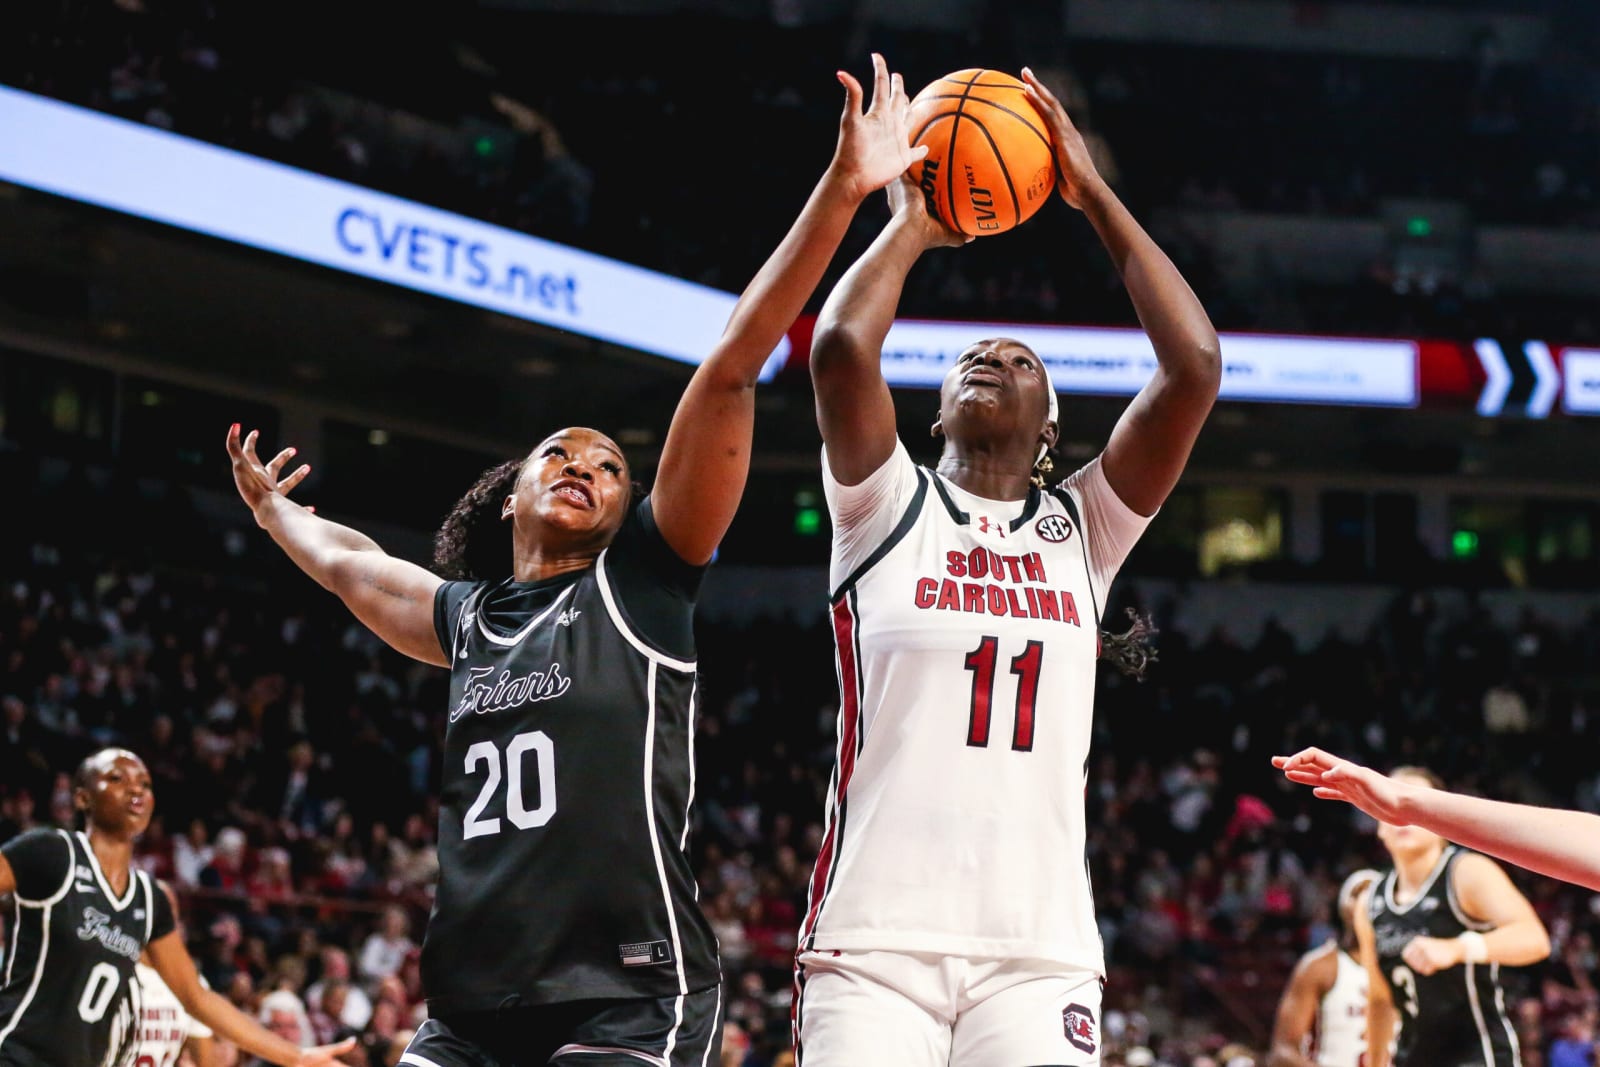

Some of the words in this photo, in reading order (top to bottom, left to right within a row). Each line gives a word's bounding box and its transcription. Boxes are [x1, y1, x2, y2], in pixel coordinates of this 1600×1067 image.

[964, 164, 976, 186] NXT
[970, 186, 1000, 231] EVO
[335, 206, 579, 316] CVETS.net
[1037, 515, 1071, 542] SEC
[946, 546, 1047, 583] SOUTH
[914, 577, 1081, 628] CAROLINA
[449, 662, 571, 723] Friars
[964, 635, 1044, 752] 11
[463, 730, 557, 841] 20
[657, 946, 665, 957] L
[78, 962, 120, 1024] 0
